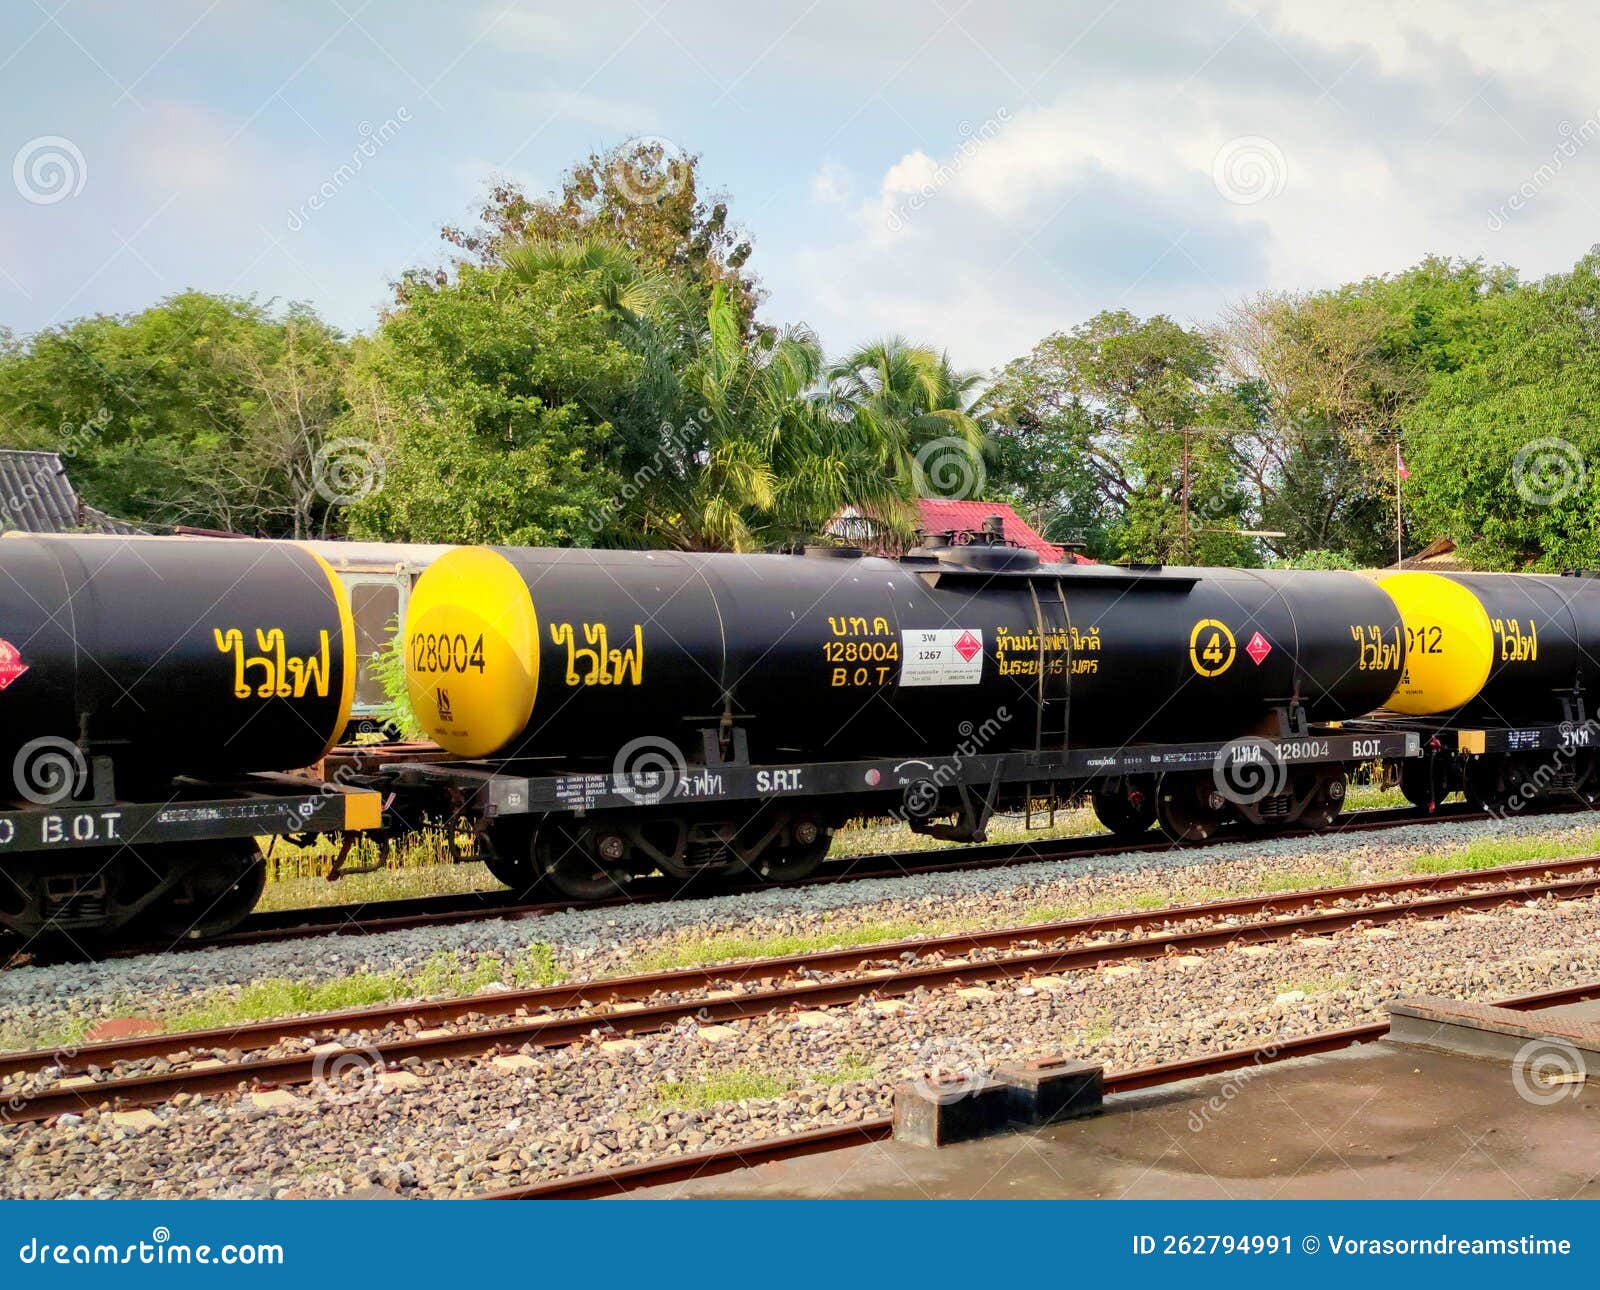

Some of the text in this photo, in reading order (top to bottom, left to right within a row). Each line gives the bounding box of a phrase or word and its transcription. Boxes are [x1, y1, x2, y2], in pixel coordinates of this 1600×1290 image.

[921, 633, 937, 642] 3W
[1203, 632, 1223, 664] 4
[1351, 625, 1401, 671] ไวไฟ
[1491, 619, 1537, 661] ไวไฟ
[213, 628, 330, 698] ไวไฟ
[410, 632, 486, 674] 128004
[550, 623, 643, 686] ไวไฟ
[823, 642, 898, 662] 128004
[919, 650, 941, 660] 1267
[832, 667, 892, 687] B.O.T.
[1275, 741, 1329, 760] 128004
[1352, 739, 1381, 757] B.O.T.
[756, 768, 803, 792] S.R.T.
[42, 812, 120, 843] B.O.T.
